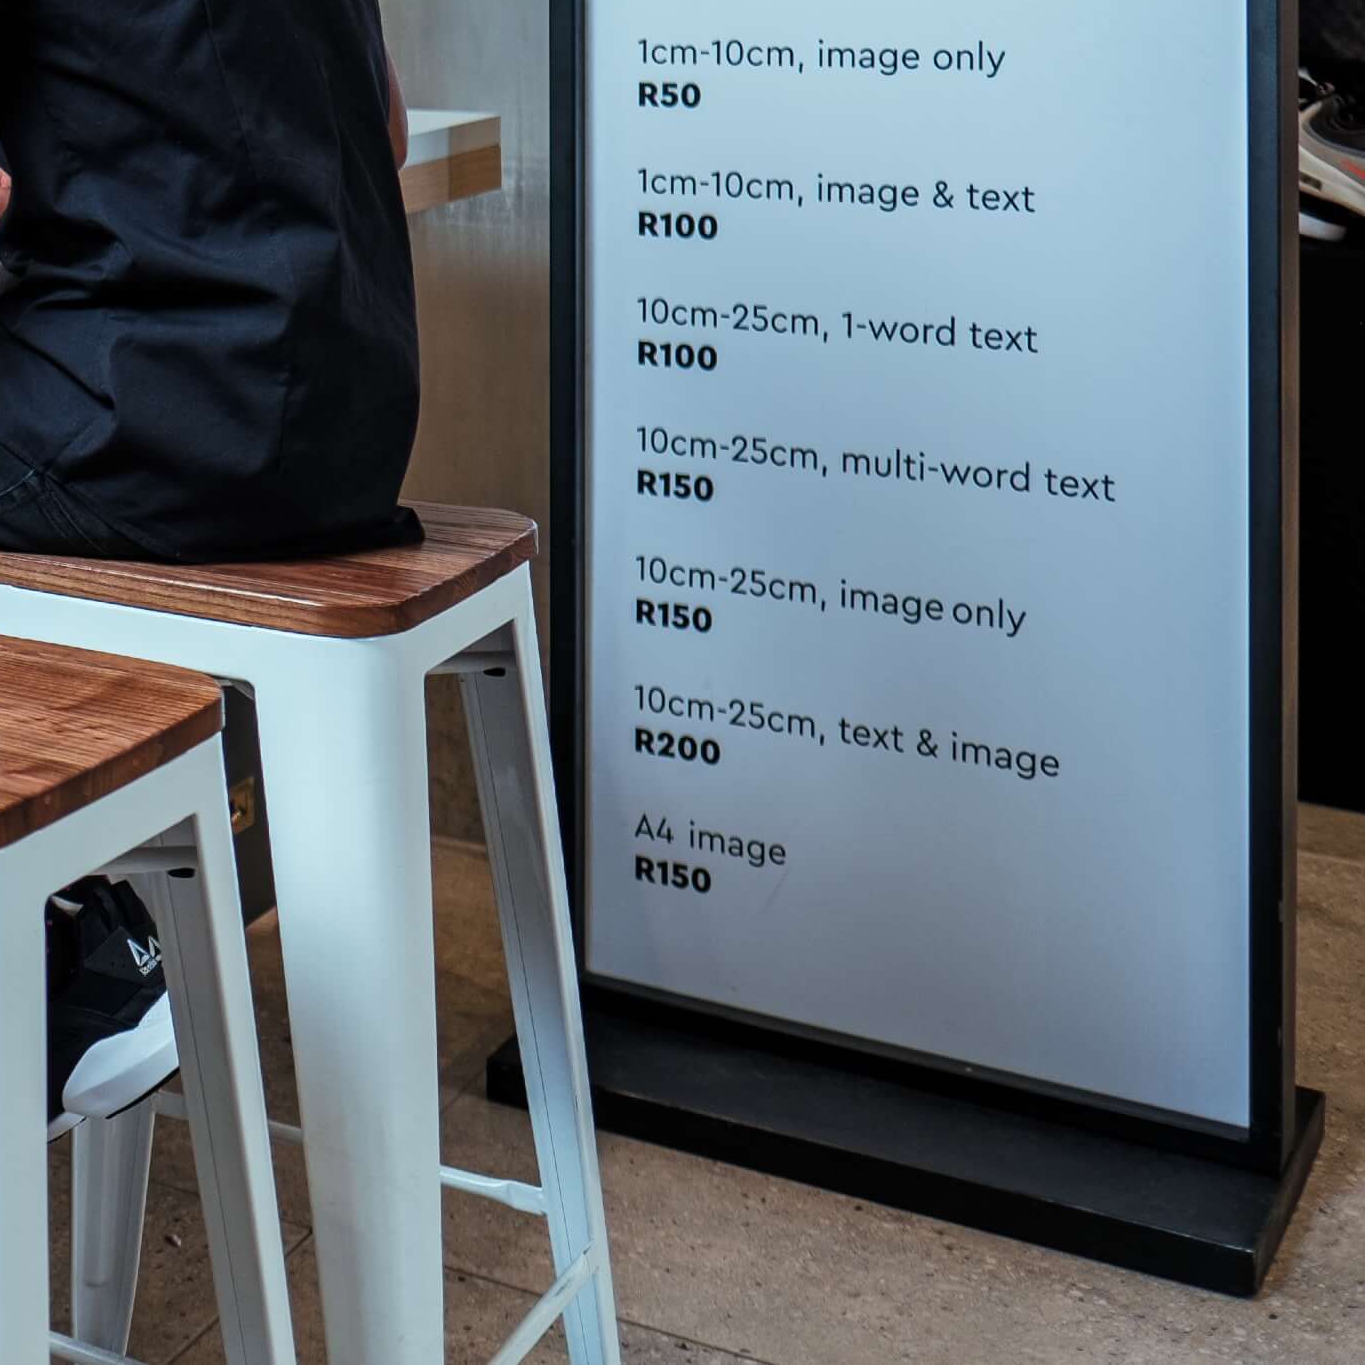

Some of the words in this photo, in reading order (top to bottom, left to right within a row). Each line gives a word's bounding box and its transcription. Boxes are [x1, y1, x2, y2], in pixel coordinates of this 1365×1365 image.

[638, 38, 804, 74] 1cm-10cm,
[818, 38, 920, 76] image
[933, 40, 1005, 78] only
[638, 80, 701, 109] R50
[638, 168, 803, 208] 1cm-10cm,
[817, 173, 919, 212] image
[933, 180, 954, 209] &
[966, 183, 1036, 213] text
[638, 207, 718, 241] R100
[637, 296, 828, 343] 10cm-25cm,
[842, 311, 956, 346] 1-word
[969, 322, 1038, 353] text
[638, 338, 717, 371] R100
[637, 426, 827, 478] 10cm-25cm,
[842, 448, 1030, 492] multi-word
[1043, 468, 1115, 502] text
[637, 467, 714, 502] R150
[636, 555, 826, 612] 10cm-25cm,
[841, 578, 944, 625] image
[952, 598, 1026, 638] only
[636, 597, 712, 634] R150
[635, 684, 825, 746] 10cm-25cm,
[838, 717, 904, 753] text
[916, 728, 938, 759] &
[952, 731, 1059, 780] image
[635, 726, 720, 766] R200
[635, 813, 674, 844] A4
[690, 819, 786, 868] image
[635, 854, 711, 894] R150
